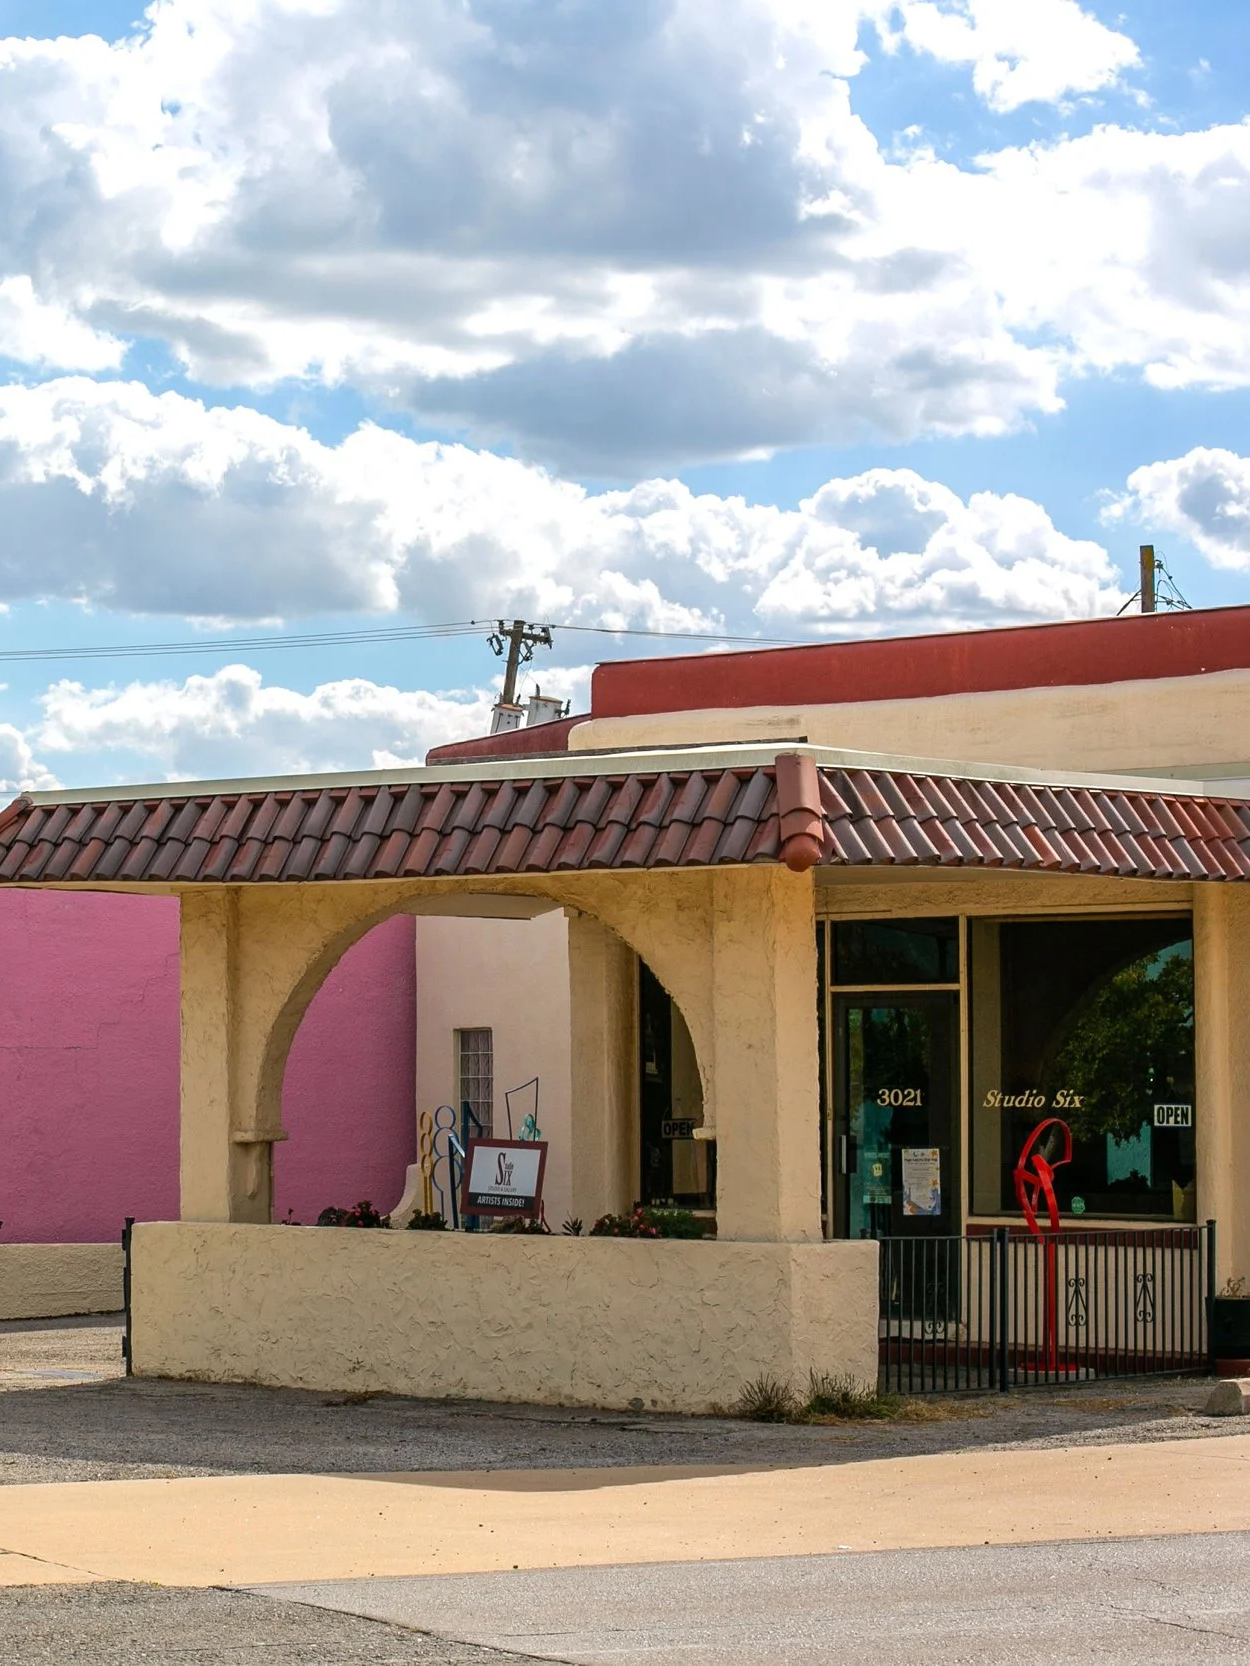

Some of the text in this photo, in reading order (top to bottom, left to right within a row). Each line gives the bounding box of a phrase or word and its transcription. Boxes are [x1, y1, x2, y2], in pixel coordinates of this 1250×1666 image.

[877, 1088, 922, 1106] 3021
[982, 1089, 1084, 1108] Studio Six
[1156, 1105, 1189, 1125] OPEN
[663, 1121, 695, 1137] OPEN
[477, 1195, 525, 1208] ARTISTS INSIDE!
